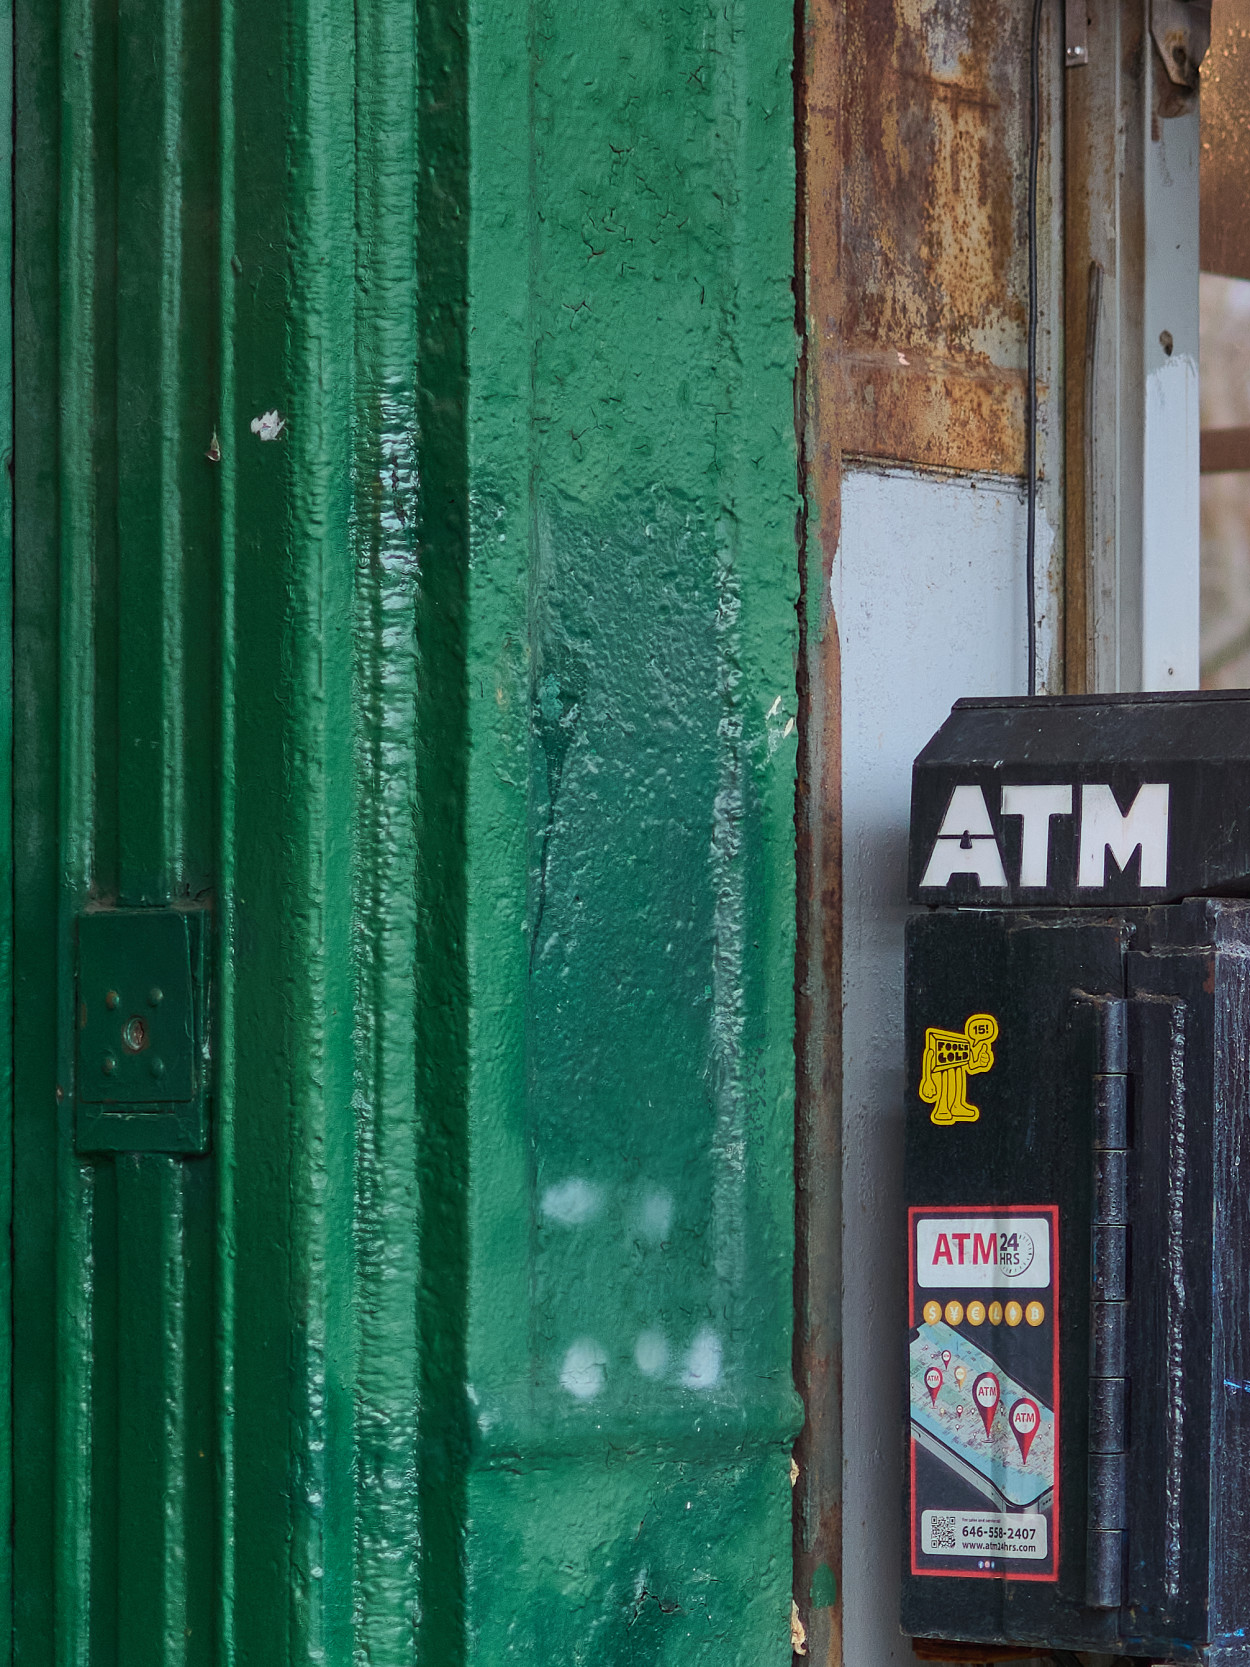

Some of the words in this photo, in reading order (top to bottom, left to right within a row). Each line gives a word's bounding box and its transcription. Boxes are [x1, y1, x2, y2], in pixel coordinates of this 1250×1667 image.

[919, 783, 1170, 887] ATM
[973, 1025, 989, 1034] 15!
[938, 1052, 968, 1063] GOLD
[932, 1233, 998, 1265] ATM
[1000, 1233, 1019, 1251] 24
[1000, 1253, 1020, 1265] HRS
[978, 1387, 997, 1396] ATM
[1014, 1413, 1035, 1423] ATM
[962, 1526, 1036, 1540] 646-558-2407
[962, 1541, 1036, 1553] www.atm24hrs.com
